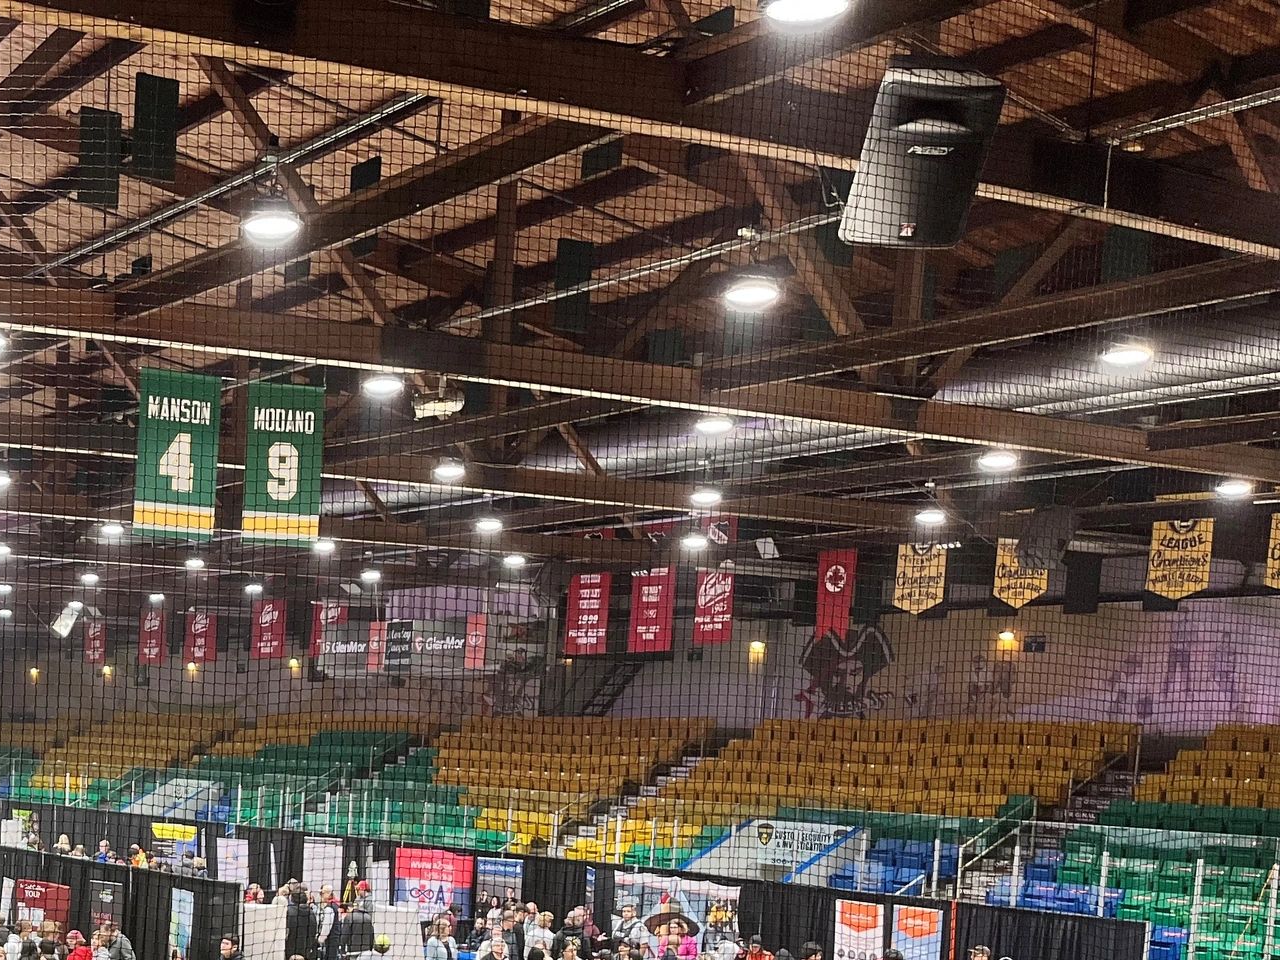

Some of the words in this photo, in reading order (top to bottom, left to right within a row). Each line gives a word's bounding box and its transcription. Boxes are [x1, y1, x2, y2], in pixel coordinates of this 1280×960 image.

[147, 395, 211, 425] MANSON
[253, 406, 315, 435] MODANO
[159, 433, 194, 493] 4
[267, 441, 299, 501] 9
[1160, 533, 1206, 550] LEAGUE
[1152, 550, 1209, 569] Champions
[426, 636, 465, 651] GlenMor
[774, 830, 800, 840] CUSTO
[801, 832, 832, 843] SECURITY
